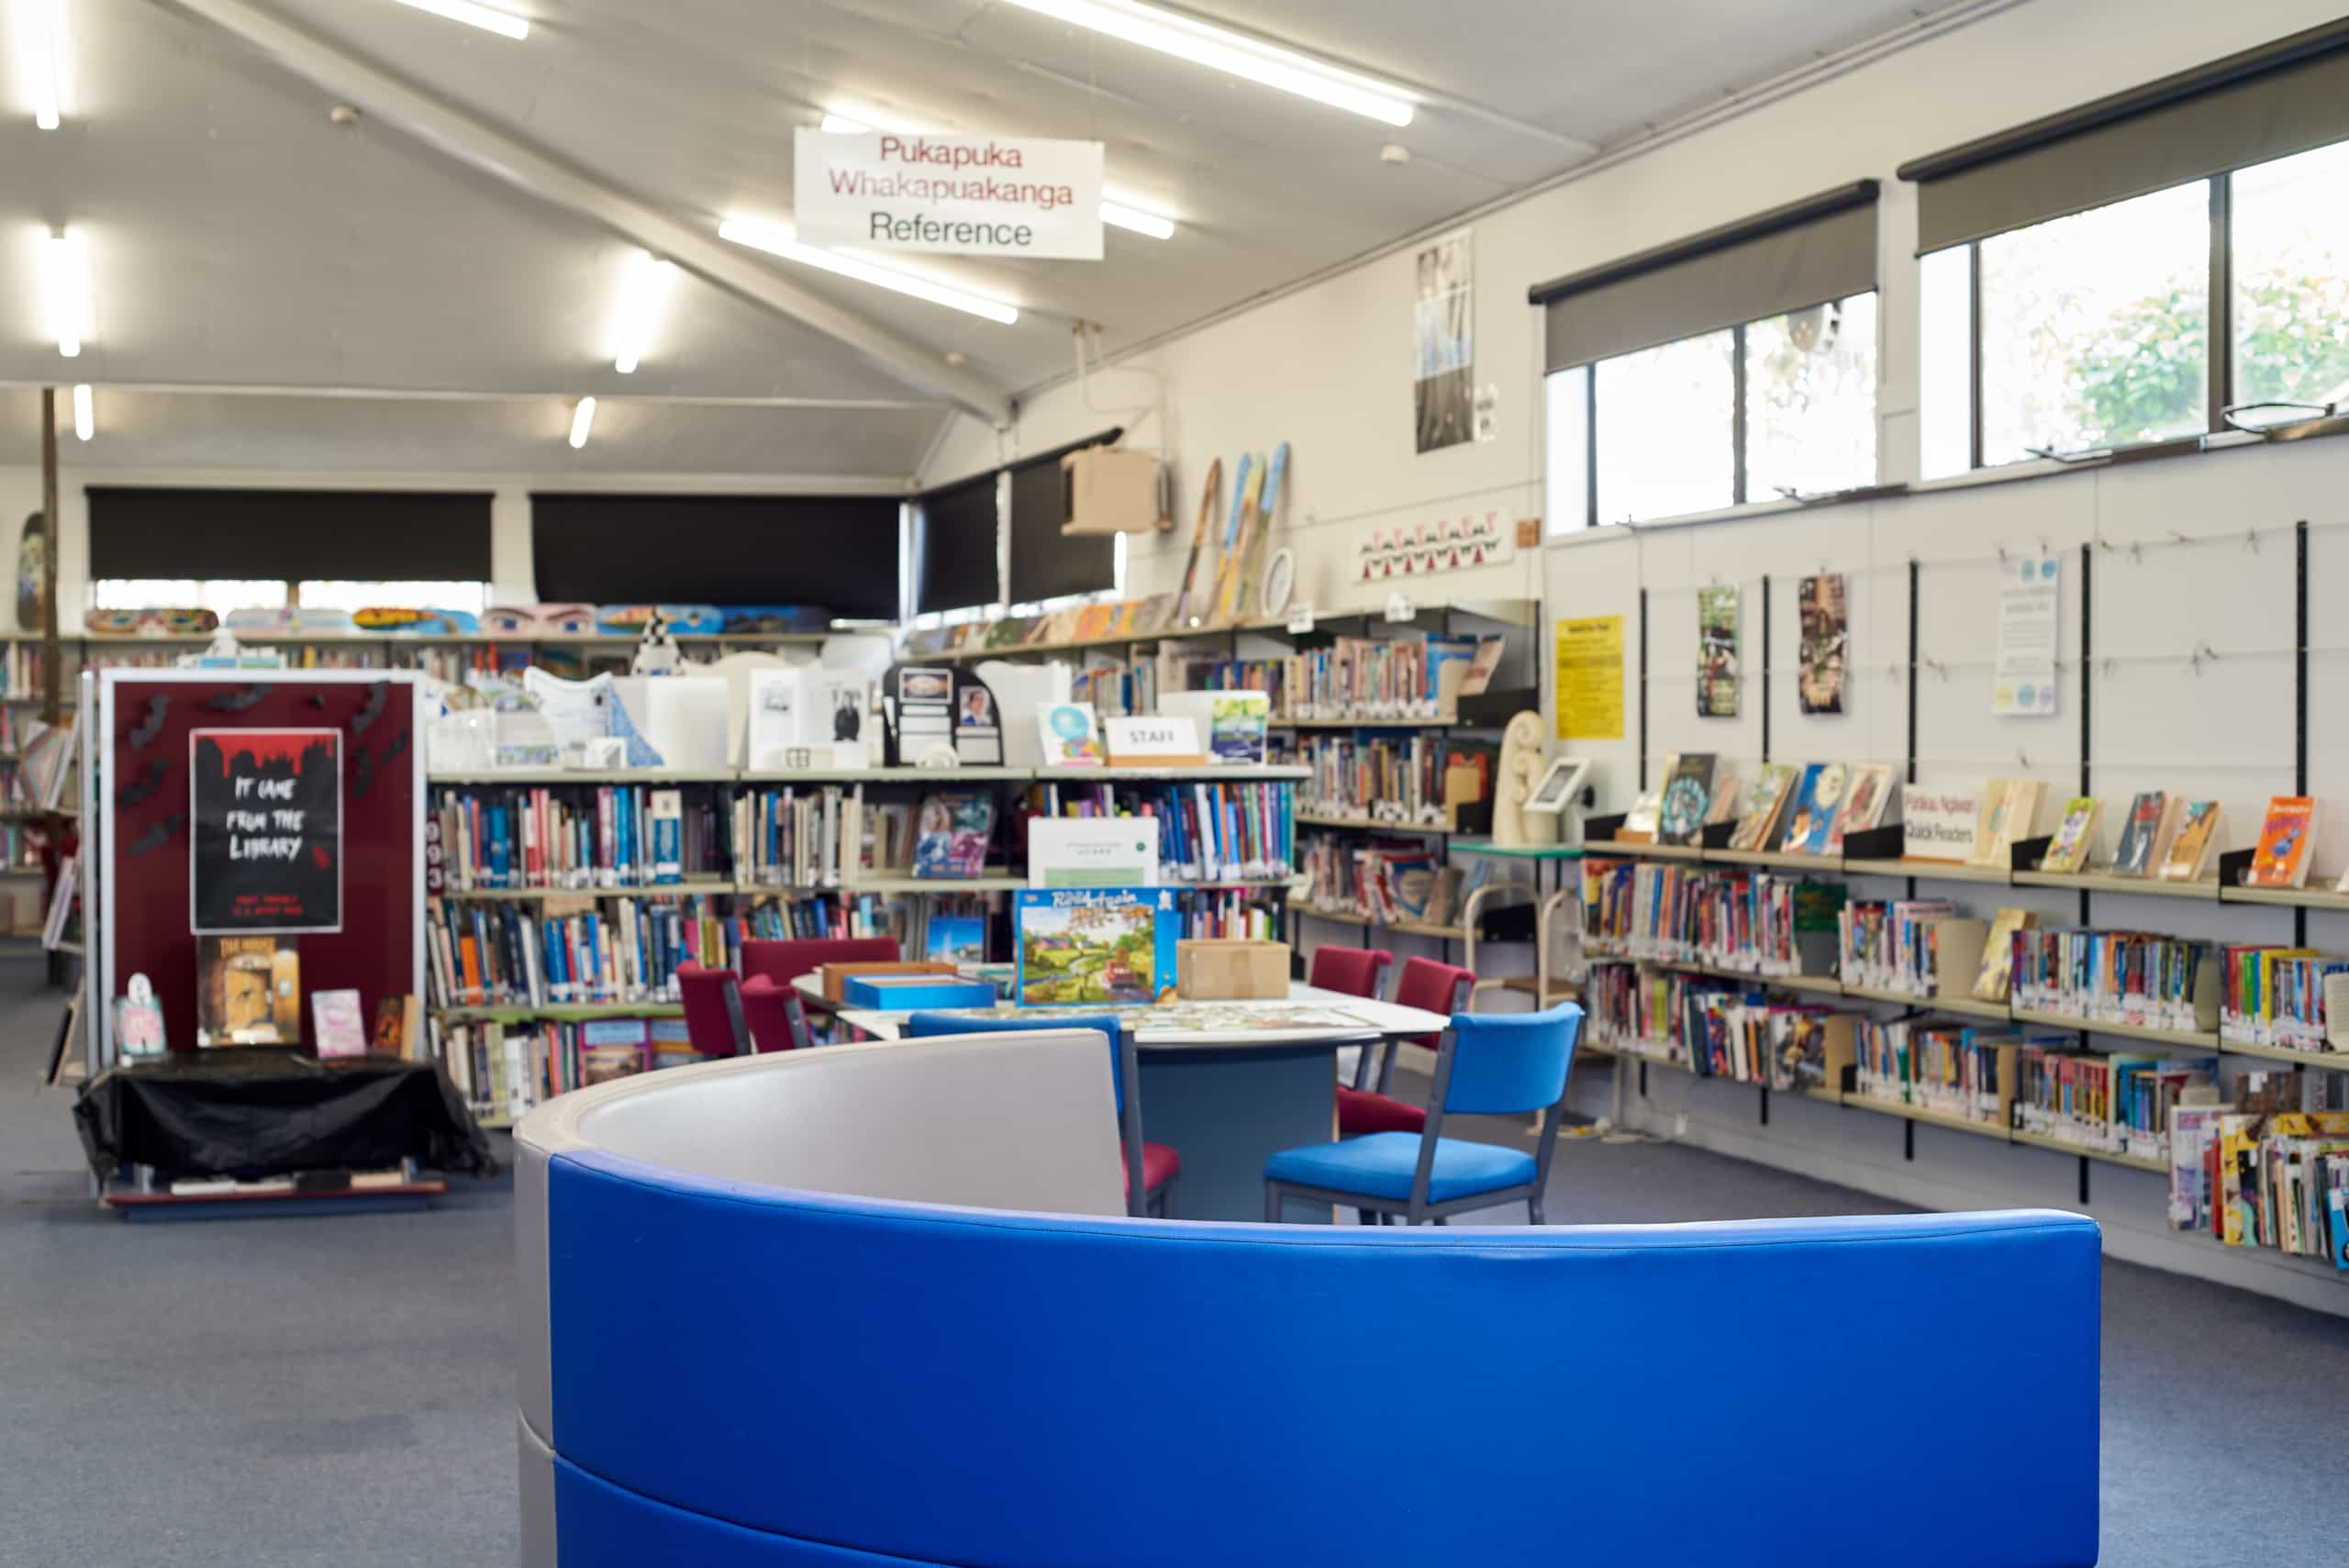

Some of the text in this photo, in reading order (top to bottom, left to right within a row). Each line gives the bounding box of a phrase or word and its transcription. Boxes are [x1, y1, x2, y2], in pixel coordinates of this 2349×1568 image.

[880, 137, 1023, 171] Pukapuka
[829, 169, 1074, 209] Whakapuakanga
[870, 212, 1032, 246] Reference
[235, 775, 296, 799] IT CAME
[227, 809, 306, 831] FROM THE
